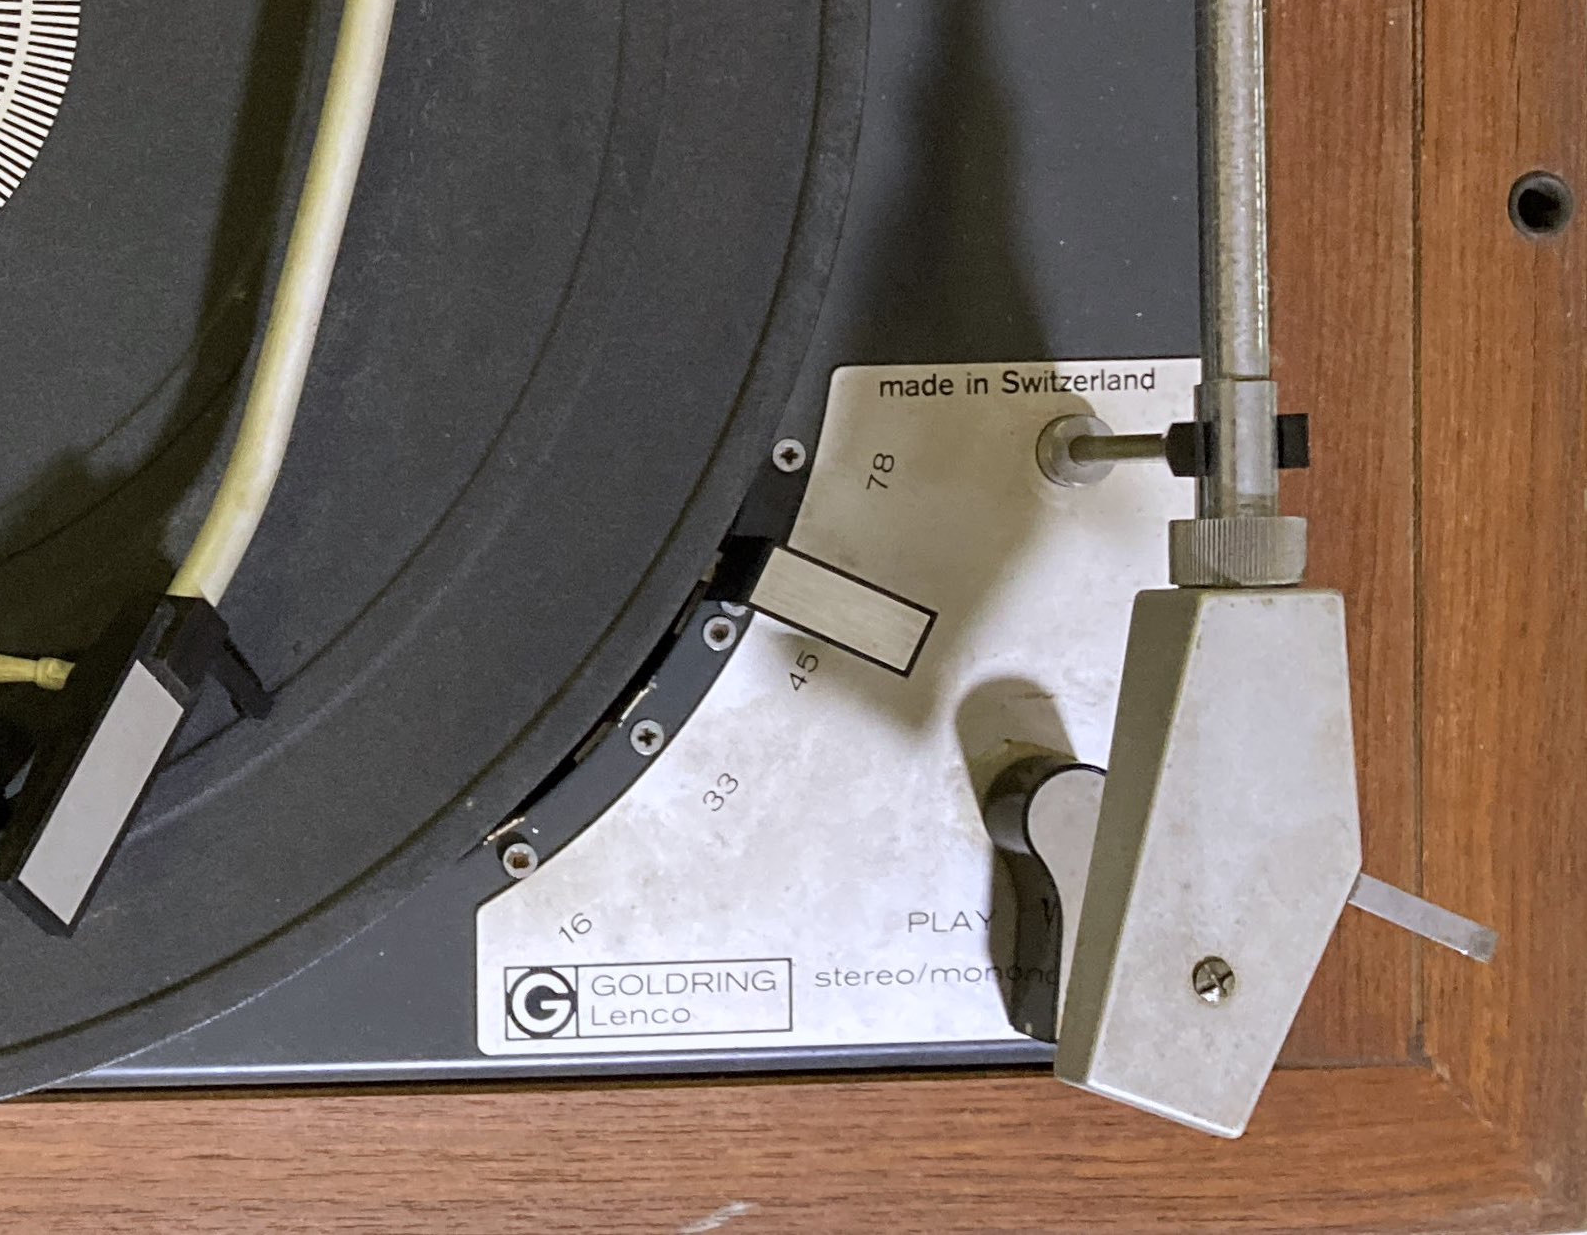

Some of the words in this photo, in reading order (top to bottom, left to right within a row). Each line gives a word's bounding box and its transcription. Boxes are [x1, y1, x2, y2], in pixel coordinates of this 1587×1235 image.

[879, 372, 954, 398] made
[966, 372, 989, 395] in
[1001, 368, 1156, 395] Switzerland
[866, 452, 895, 491] 78
[789, 653, 819, 692] 45
[702, 772, 740, 813] 33
[558, 911, 593, 945] 16
[907, 909, 995, 934] PLAY
[590, 969, 777, 997] GOLDRING
[590, 1005, 692, 1027] Lenco
